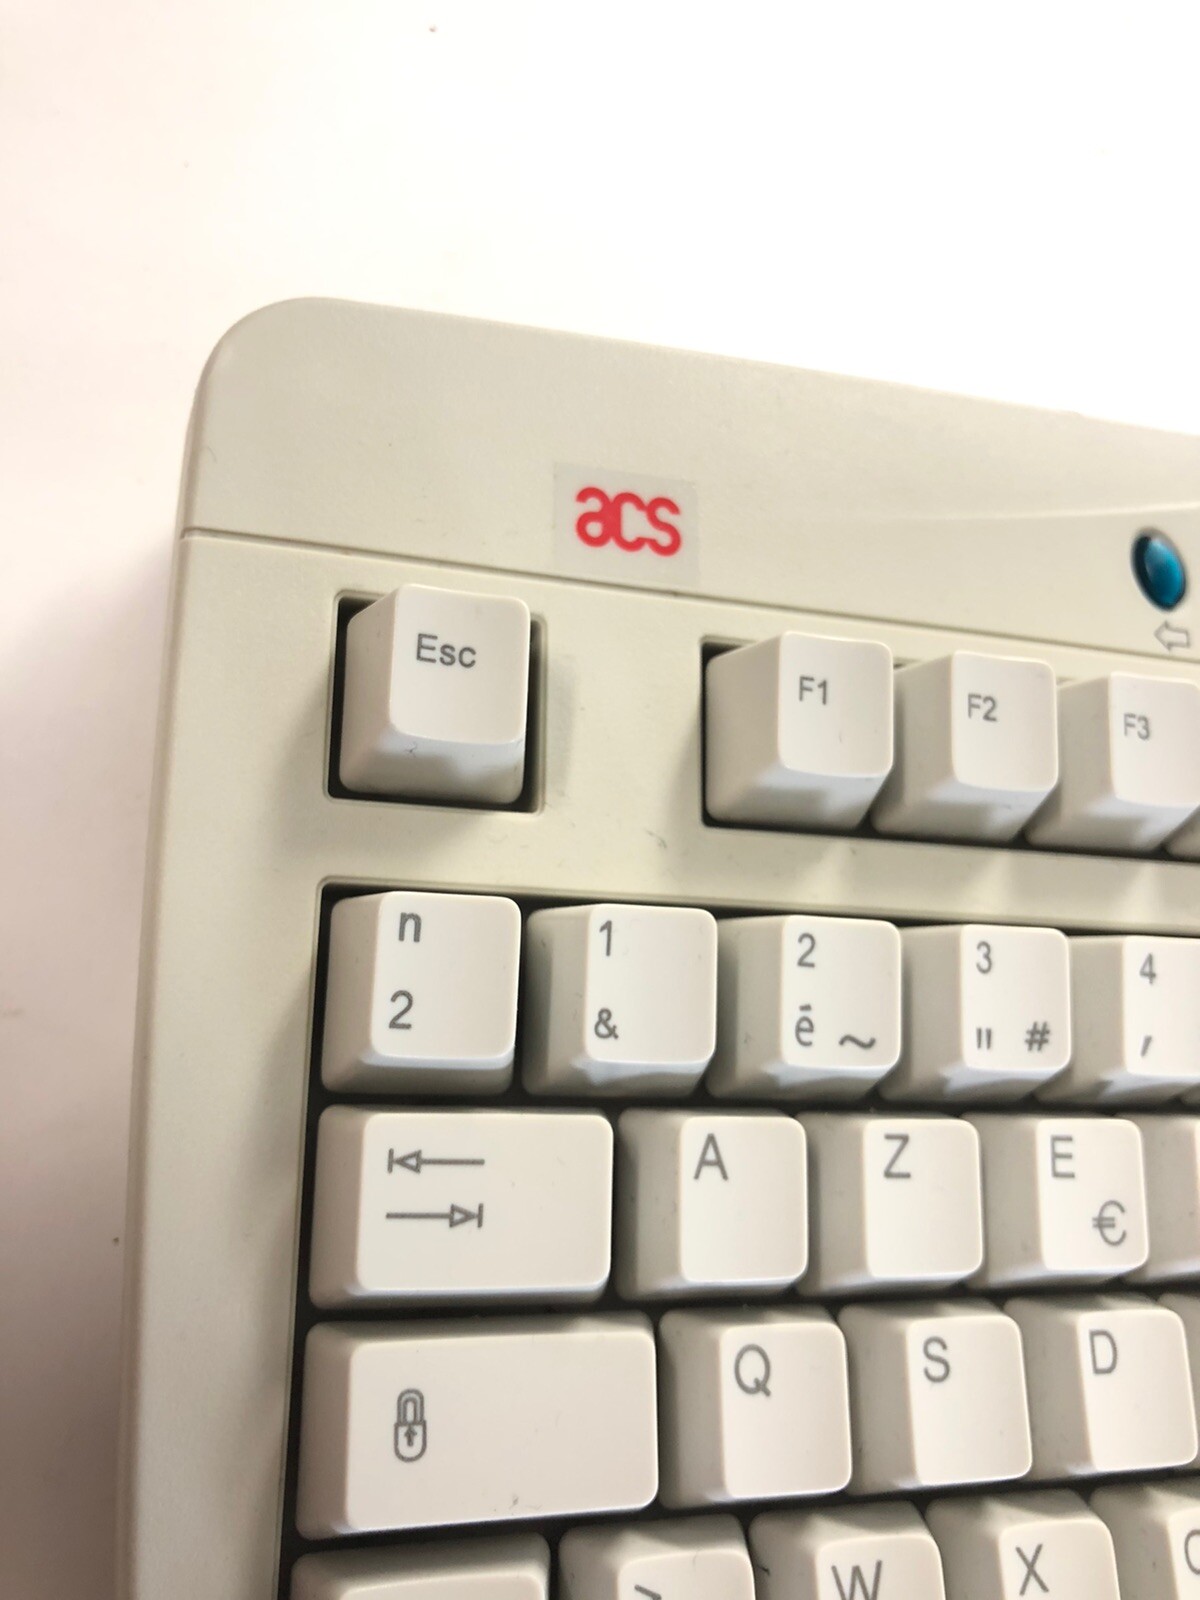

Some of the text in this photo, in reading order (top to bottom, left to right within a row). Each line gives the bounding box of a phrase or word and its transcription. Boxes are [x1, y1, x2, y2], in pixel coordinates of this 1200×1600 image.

[416, 633, 476, 668] Esc
[799, 676, 827, 705] F1
[968, 694, 997, 722] F2
[1124, 713, 1151, 740] F3
[600, 920, 612, 956] 1
[797, 933, 816, 968] 2
[977, 941, 992, 974] 3
[1140, 954, 1157, 984] 4
[389, 990, 413, 1030] 2
[594, 1008, 619, 1039] &
[839, 1035, 876, 1050] ~
[1025, 1022, 1050, 1051] #
[694, 1133, 728, 1181] A
[884, 1134, 911, 1179] Z
[1051, 1135, 1075, 1179] E
[1093, 1200, 1127, 1247] €
[734, 1344, 771, 1397] Q
[923, 1337, 950, 1383] S
[1089, 1330, 1118, 1375] D
[832, 1560, 882, 1600] W
[1016, 1544, 1049, 1596] X
